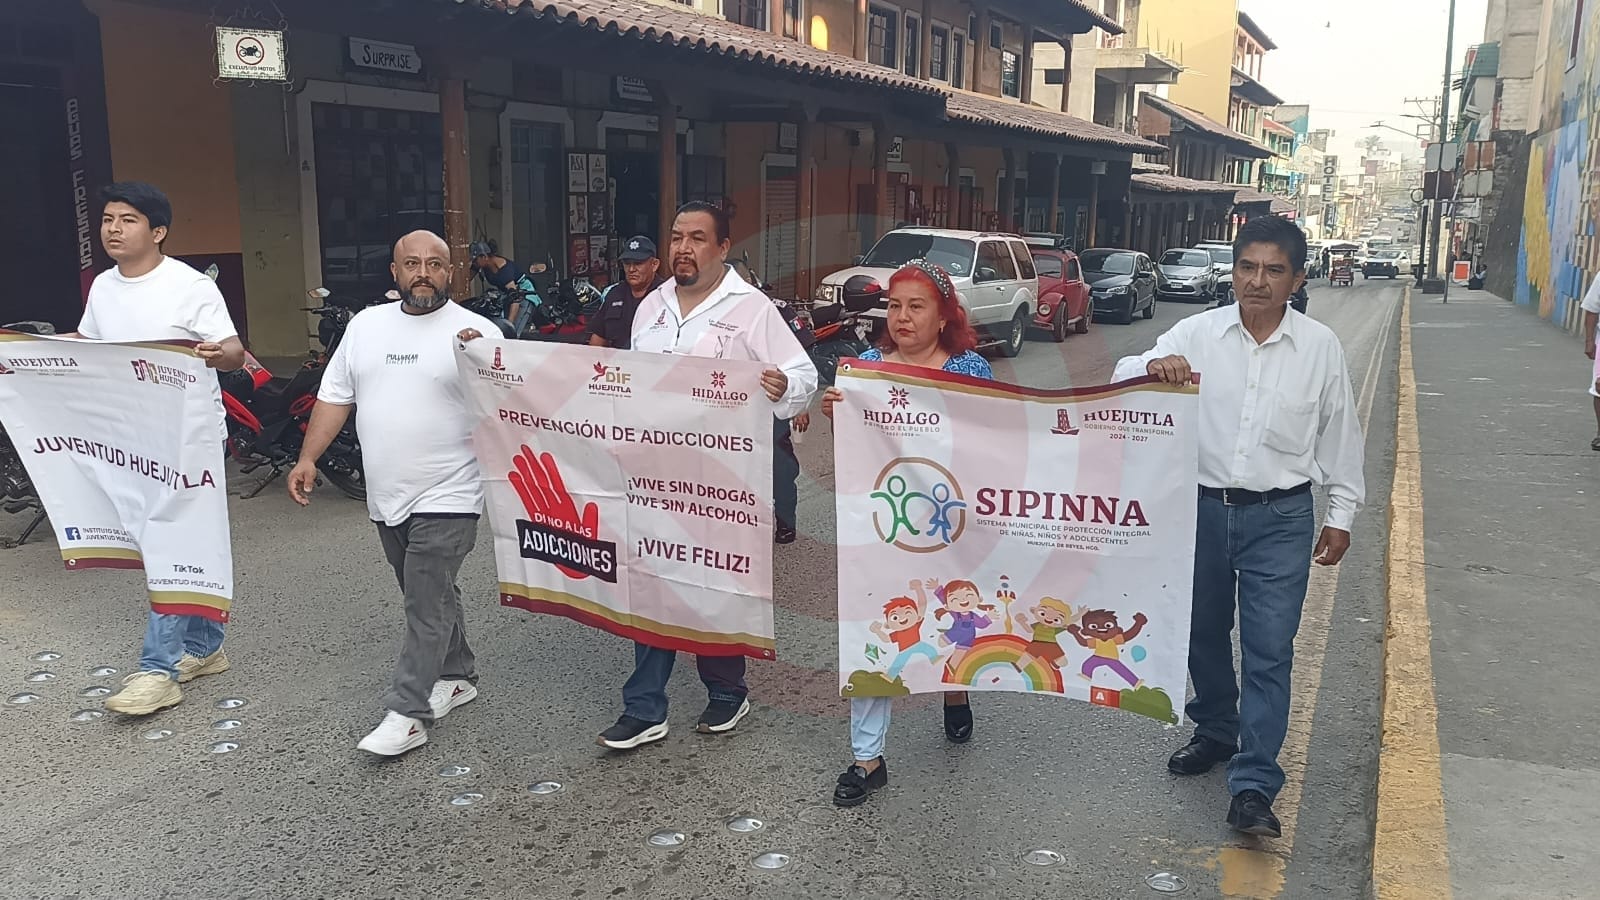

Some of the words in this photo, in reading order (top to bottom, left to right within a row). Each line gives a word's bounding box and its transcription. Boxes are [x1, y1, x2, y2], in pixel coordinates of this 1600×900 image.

[362, 44, 412, 69] SURPRISE
[1321, 157, 1336, 202] HOTEL
[72, 169, 93, 270] FRESCAS
[8, 358, 79, 368] HUEJUTLA
[158, 365, 197, 383] JUVENTUD
[478, 368, 524, 383] HUEJUTLA
[605, 370, 632, 384] DIF
[588, 383, 632, 394] HUEJUTLA
[692, 387, 749, 402] HIDALGO
[863, 409, 940, 425] HIDALGO
[864, 421, 896, 431] PRIMERO
[1083, 409, 1175, 427] HUEJUTLA
[498, 408, 607, 440] PREVENCIÓN
[612, 426, 636, 442] DE
[640, 429, 754, 452] ADICCIONES
[1084, 423, 1117, 431] GOBIERNO
[1131, 427, 1175, 436] TRANSFORMA
[33, 436, 126, 467] JUVENTUD
[129, 453, 216, 491] HUEJUTLA
[628, 476, 666, 492] ¡VIVE
[669, 480, 693, 494] SIN
[696, 483, 756, 507] DROGAS
[625, 492, 658, 509] VIVE
[661, 498, 685, 513] SIN
[687, 501, 759, 527] ALCOHOL!
[975, 487, 1150, 527] SIPINNA
[534, 512, 547, 524] DI
[547, 515, 563, 528] NO
[565, 520, 573, 532] A
[573, 523, 592, 538] LAS
[976, 518, 1007, 528] SISTEMA
[1008, 521, 1050, 531] MUNICIPAL
[1063, 525, 1112, 536] PROTECCIÓN
[1011, 529, 1036, 539] NIÑAS,
[1037, 531, 1062, 540] NIÑOS
[1069, 534, 1129, 545] ADOLESCENTES
[523, 528, 612, 573] ADICCIONES
[637, 537, 687, 562] ¡VIVE
[692, 546, 750, 574] FELIZ!
[173, 564, 205, 575] TikTok
